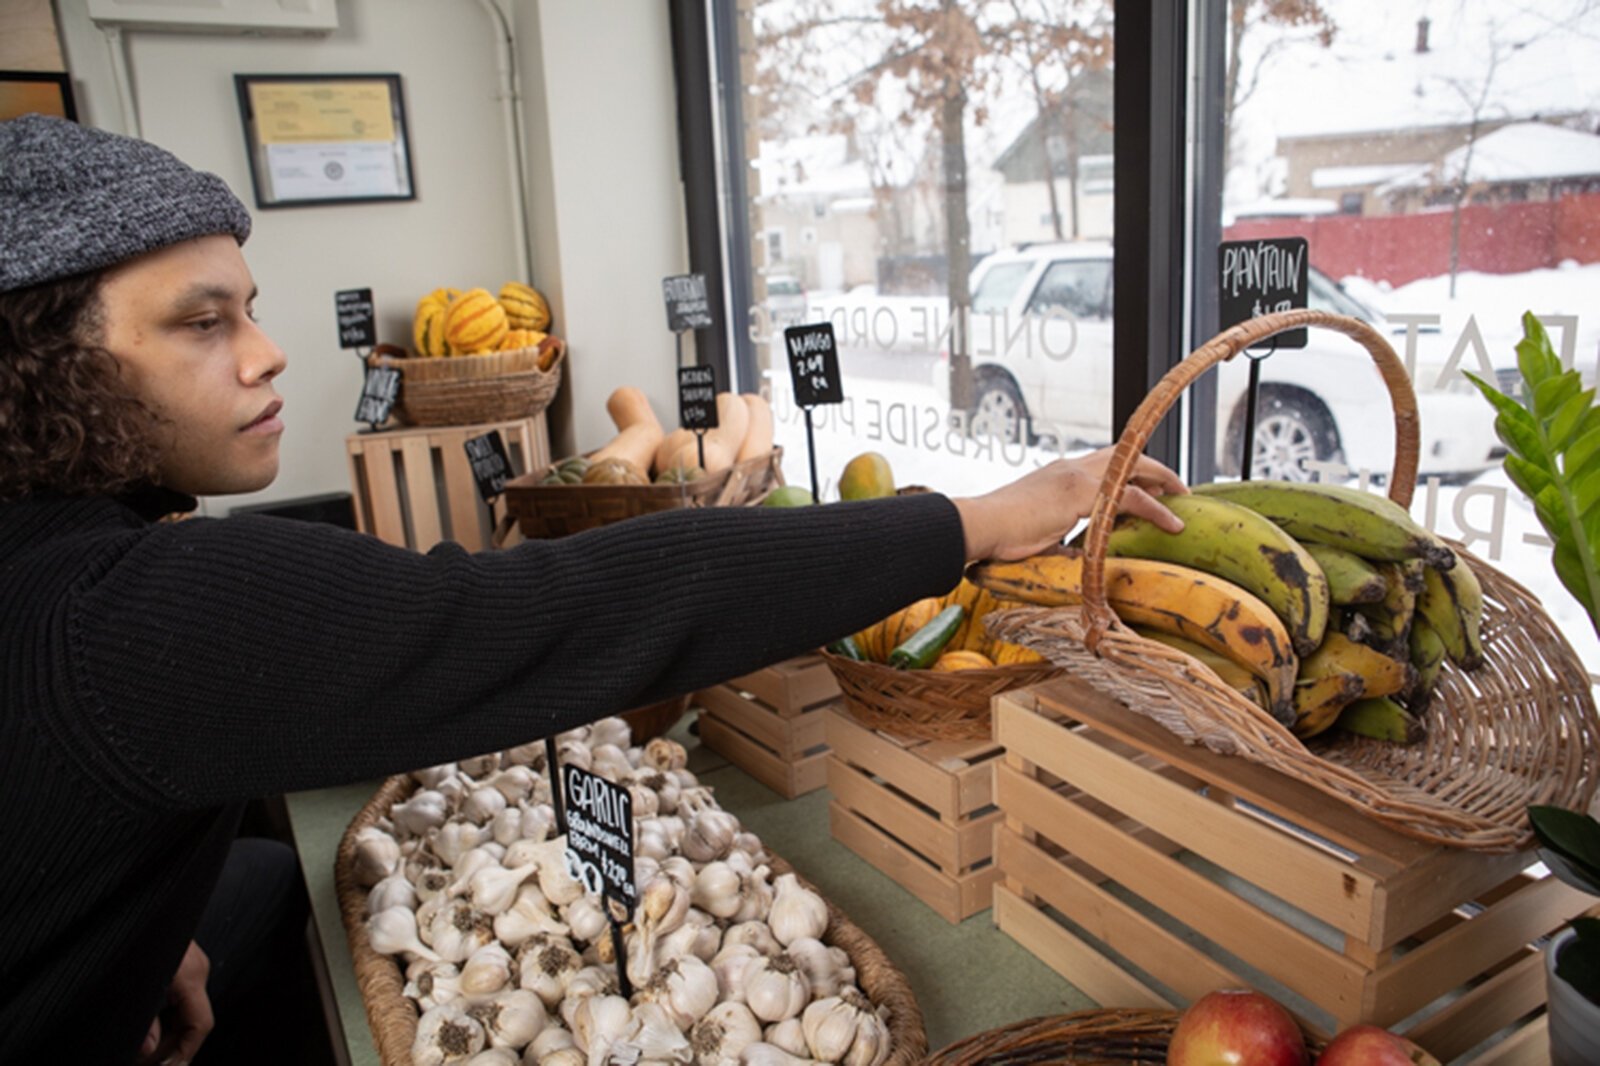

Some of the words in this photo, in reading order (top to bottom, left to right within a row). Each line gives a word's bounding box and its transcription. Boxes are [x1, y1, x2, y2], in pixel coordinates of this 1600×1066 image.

[1223, 241, 1305, 297] PLANTAIN
[790, 332, 832, 357] MANGO
[568, 769, 630, 838] GARLIC
